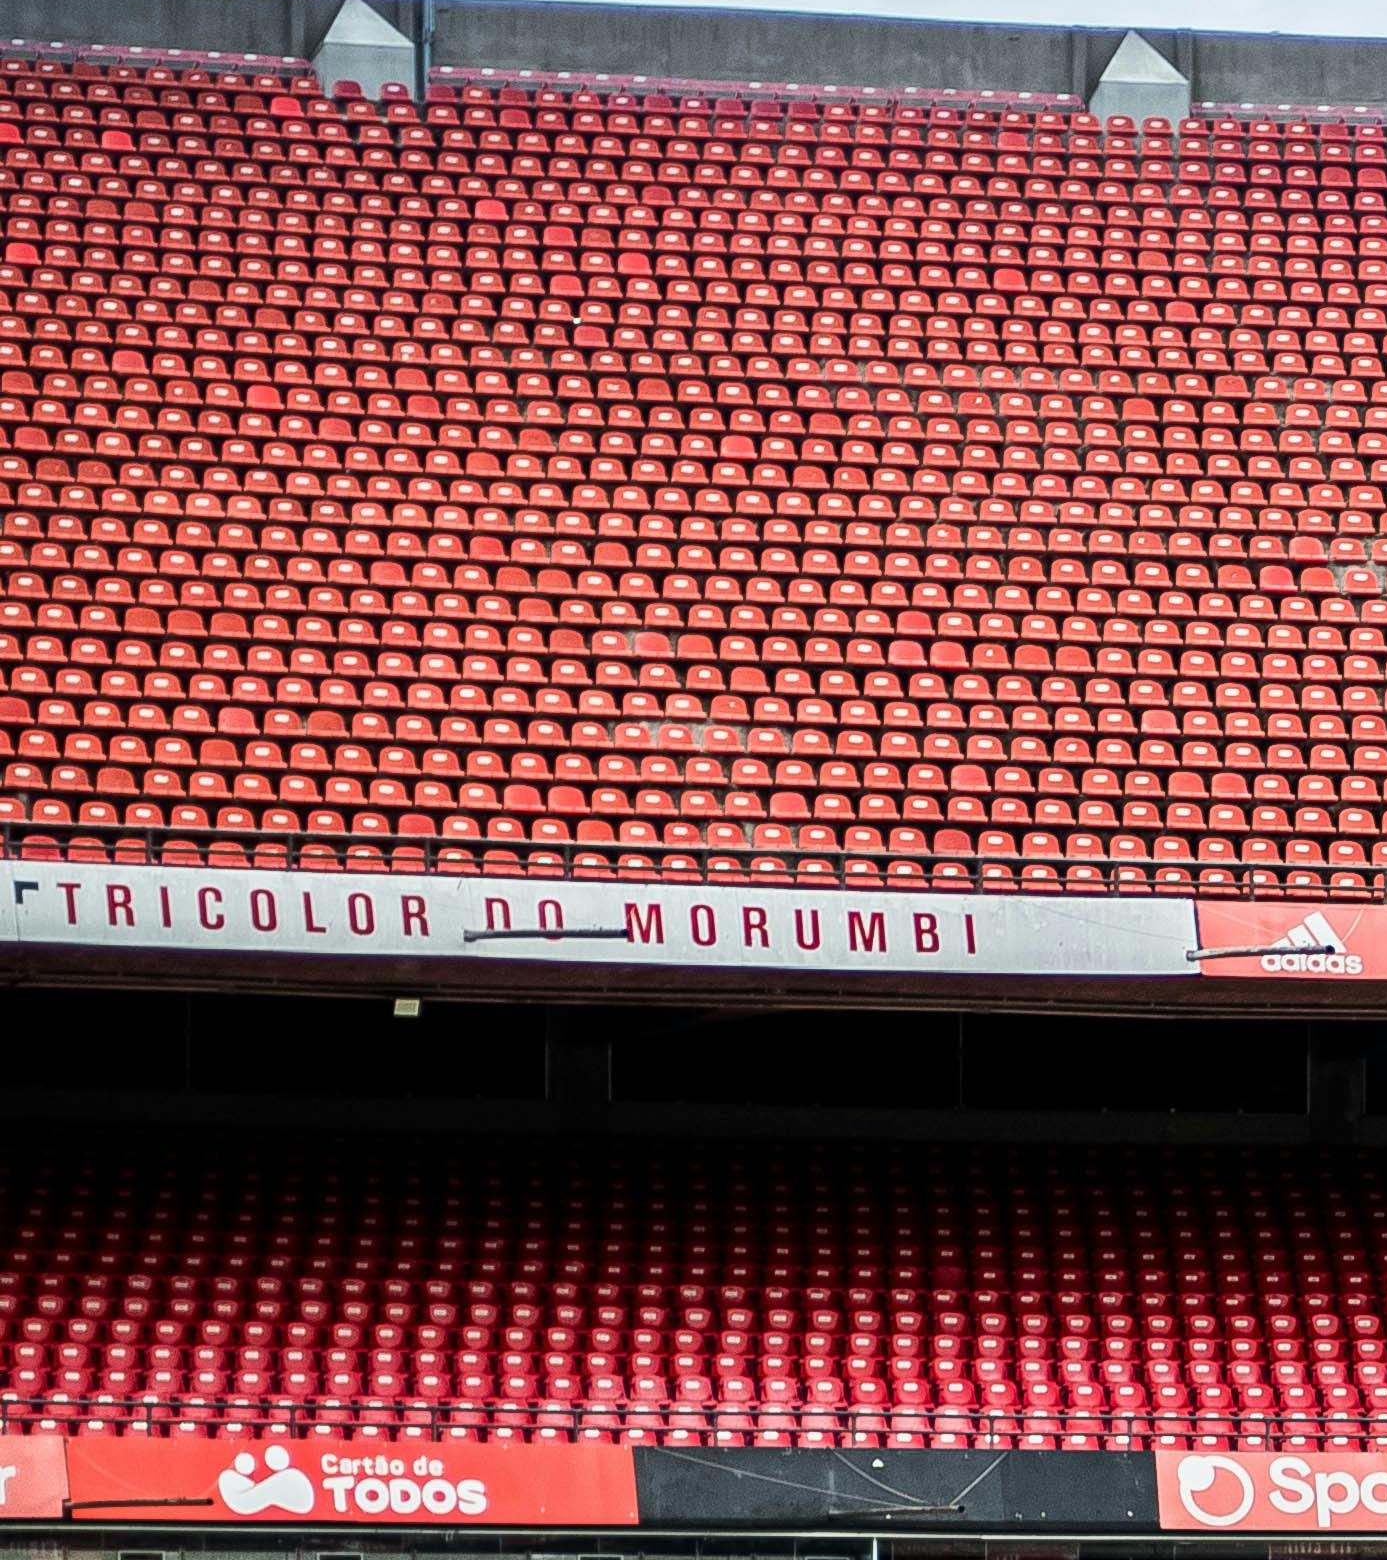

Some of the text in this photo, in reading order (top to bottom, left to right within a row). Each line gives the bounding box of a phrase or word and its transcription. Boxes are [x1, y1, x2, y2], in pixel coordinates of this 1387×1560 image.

[58, 883, 976, 955] TRICOLOR DO MORUMBI
[321, 1453, 444, 1477] Cartão de
[322, 1476, 488, 1515] TODOS
